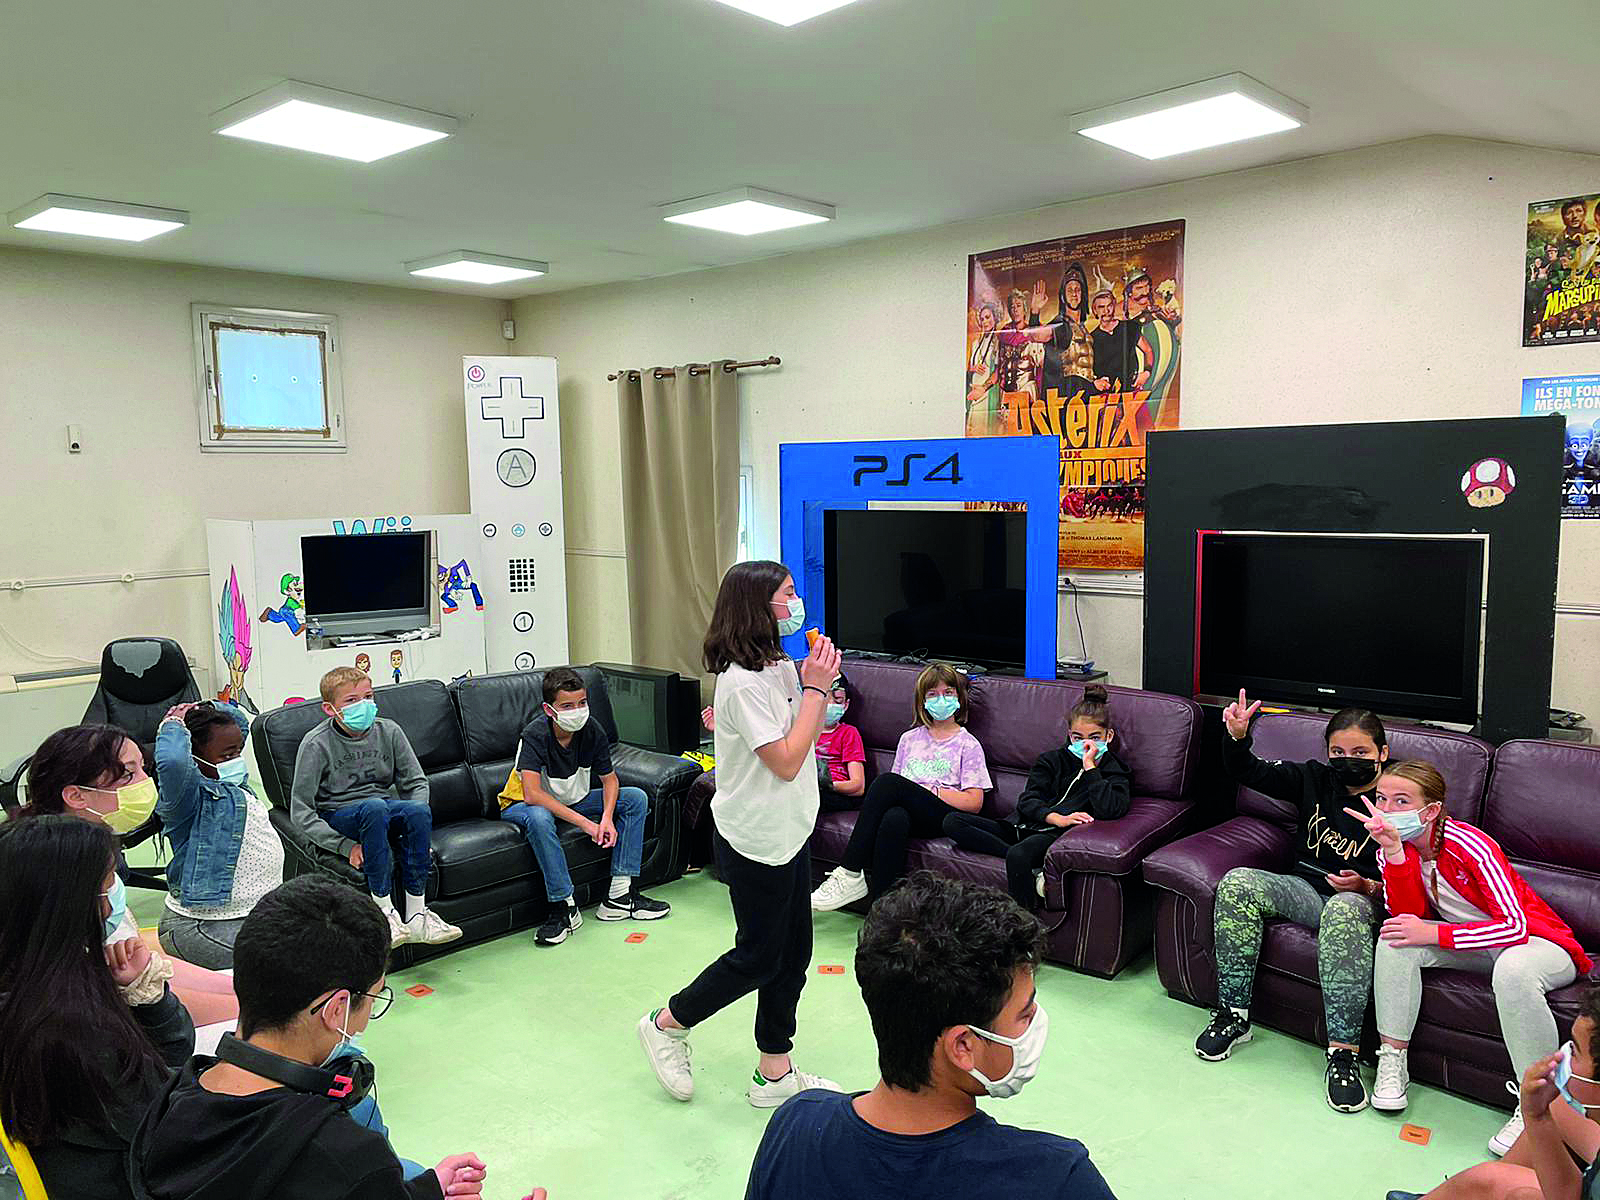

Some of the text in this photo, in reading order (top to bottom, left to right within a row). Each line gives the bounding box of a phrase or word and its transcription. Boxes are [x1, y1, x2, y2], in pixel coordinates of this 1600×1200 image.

[1535, 387, 1552, 399] ILS
[1556, 386, 1572, 398] EN
[506, 454, 527, 480] A
[853, 452, 963, 486] PS4
[1568, 494, 1589, 505] 3D
[518, 615, 527, 628] 1
[520, 657, 530, 669] 2
